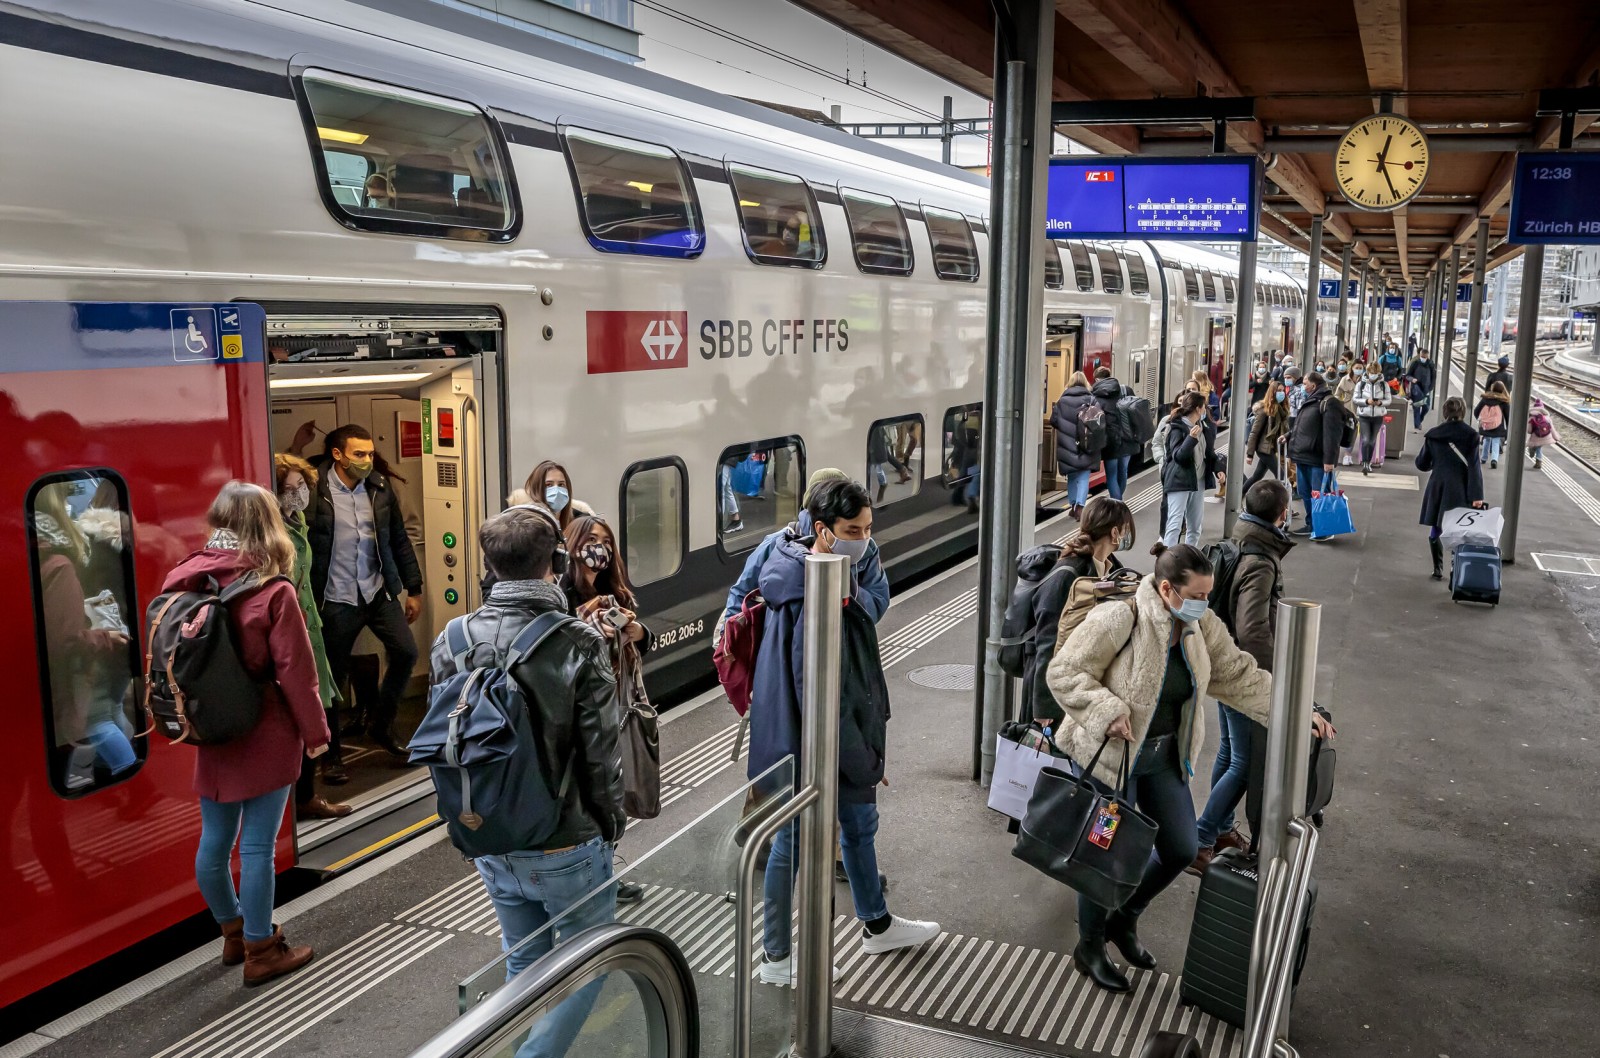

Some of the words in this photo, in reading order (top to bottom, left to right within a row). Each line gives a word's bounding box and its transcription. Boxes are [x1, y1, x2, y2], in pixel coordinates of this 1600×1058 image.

[1086, 172, 1100, 180] IC
[1532, 168, 1572, 180] 12:38
[1046, 218, 1072, 230] allen
[1524, 221, 1573, 233] Zürich
[1578, 222, 1600, 233] HB
[1325, 285, 1332, 295] 7
[700, 319, 752, 360] SBB
[762, 318, 804, 356] CFF
[813, 318, 849, 353] FFS
[660, 630, 676, 648] 502
[678, 620, 704, 640] 206-8
